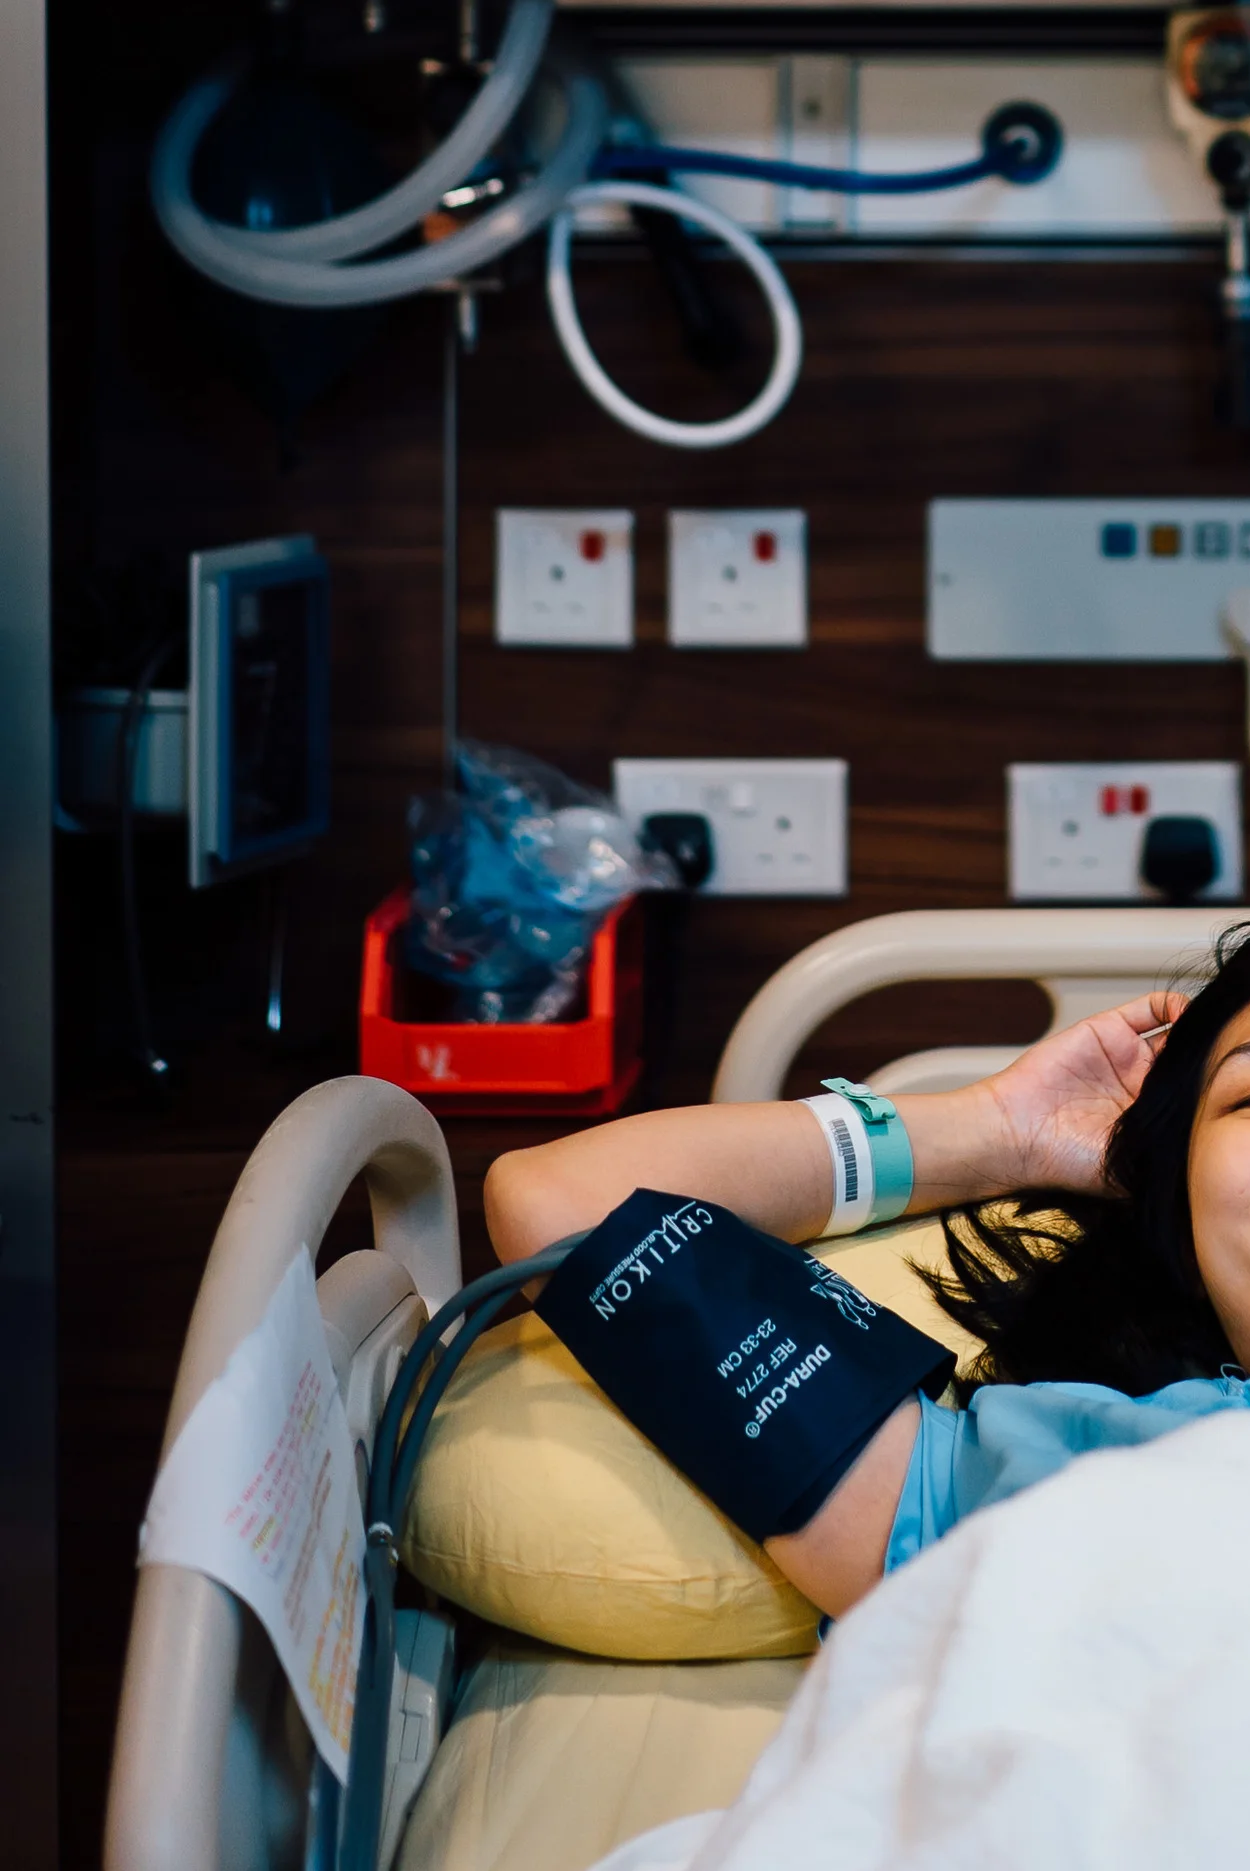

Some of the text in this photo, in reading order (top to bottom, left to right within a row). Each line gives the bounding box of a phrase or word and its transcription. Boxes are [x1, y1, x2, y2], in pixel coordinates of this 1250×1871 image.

[595, 1207, 714, 1321] CRITIKON
[603, 1253, 635, 1287] PRESSURE
[633, 1233, 656, 1257] BLOOD
[717, 1318, 777, 1380] 23-33 CM
[736, 1337, 798, 1399] REF 2774
